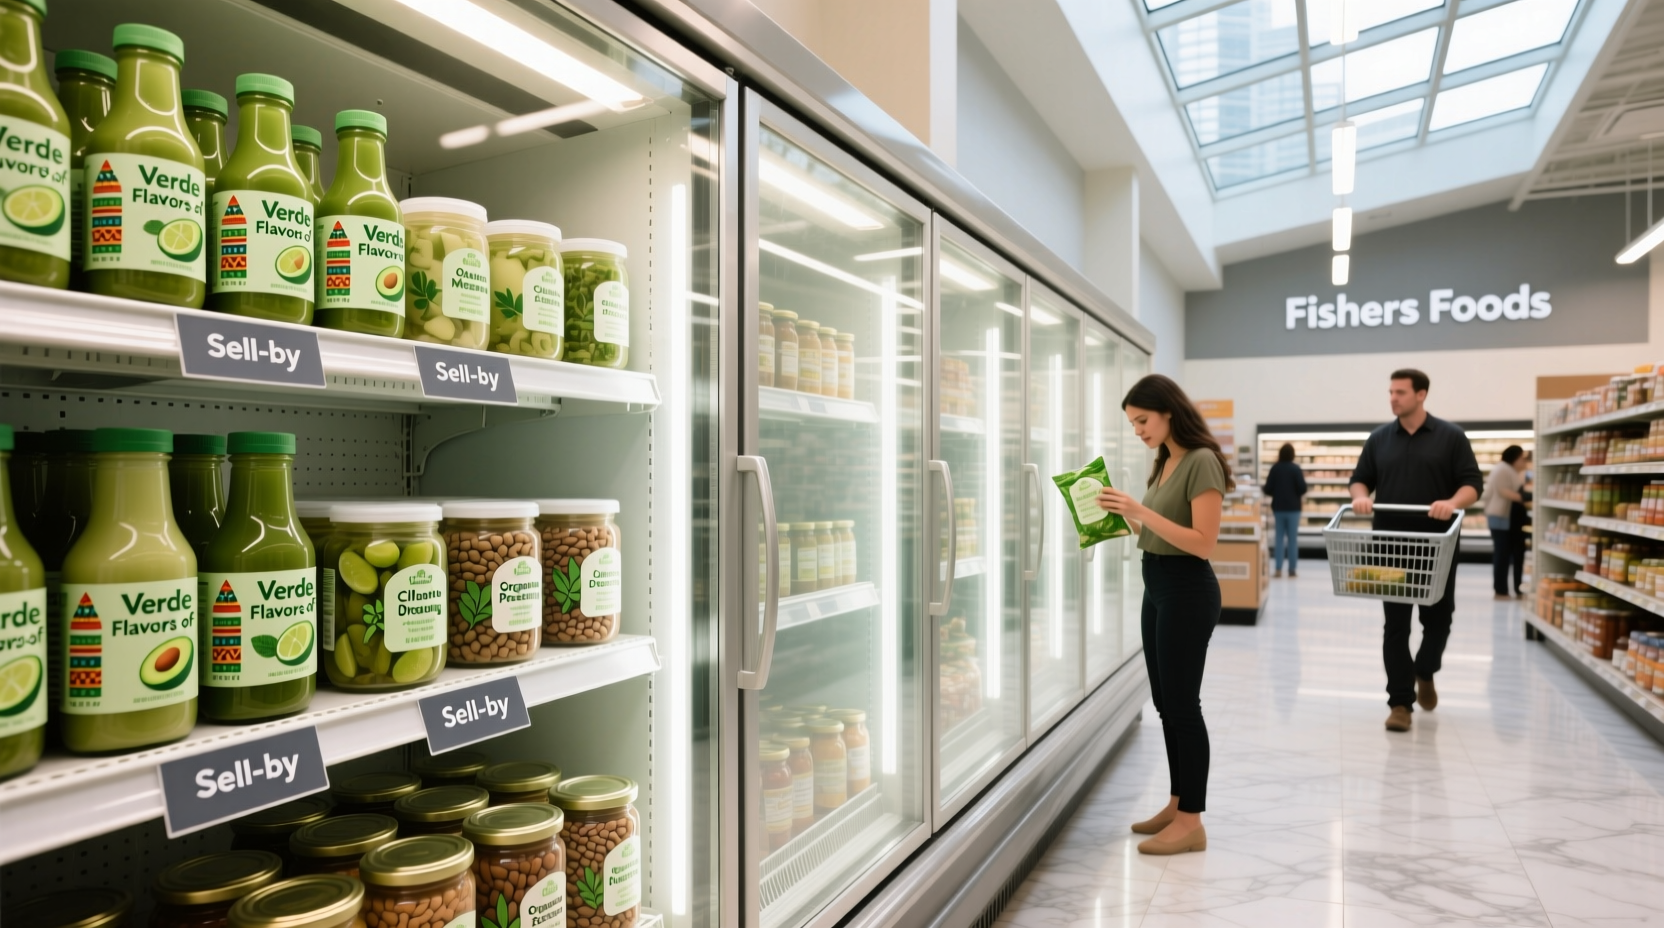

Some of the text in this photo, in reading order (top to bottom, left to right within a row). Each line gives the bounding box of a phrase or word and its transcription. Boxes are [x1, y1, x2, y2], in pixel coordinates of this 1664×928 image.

[138, 164, 201, 198] Verde
[261, 199, 311, 228] Verde
[1286, 283, 1553, 330] Fishers Foods
[207, 332, 301, 373] Sell-by
[435, 361, 500, 392] Sell-by
[121, 588, 192, 616] Verde
[257, 576, 314, 601] Verde
[0, 601, 41, 629] rde
[112, 611, 195, 637] Flavors of
[441, 695, 510, 729] Sell-by
[195, 752, 299, 799] Sell-by
